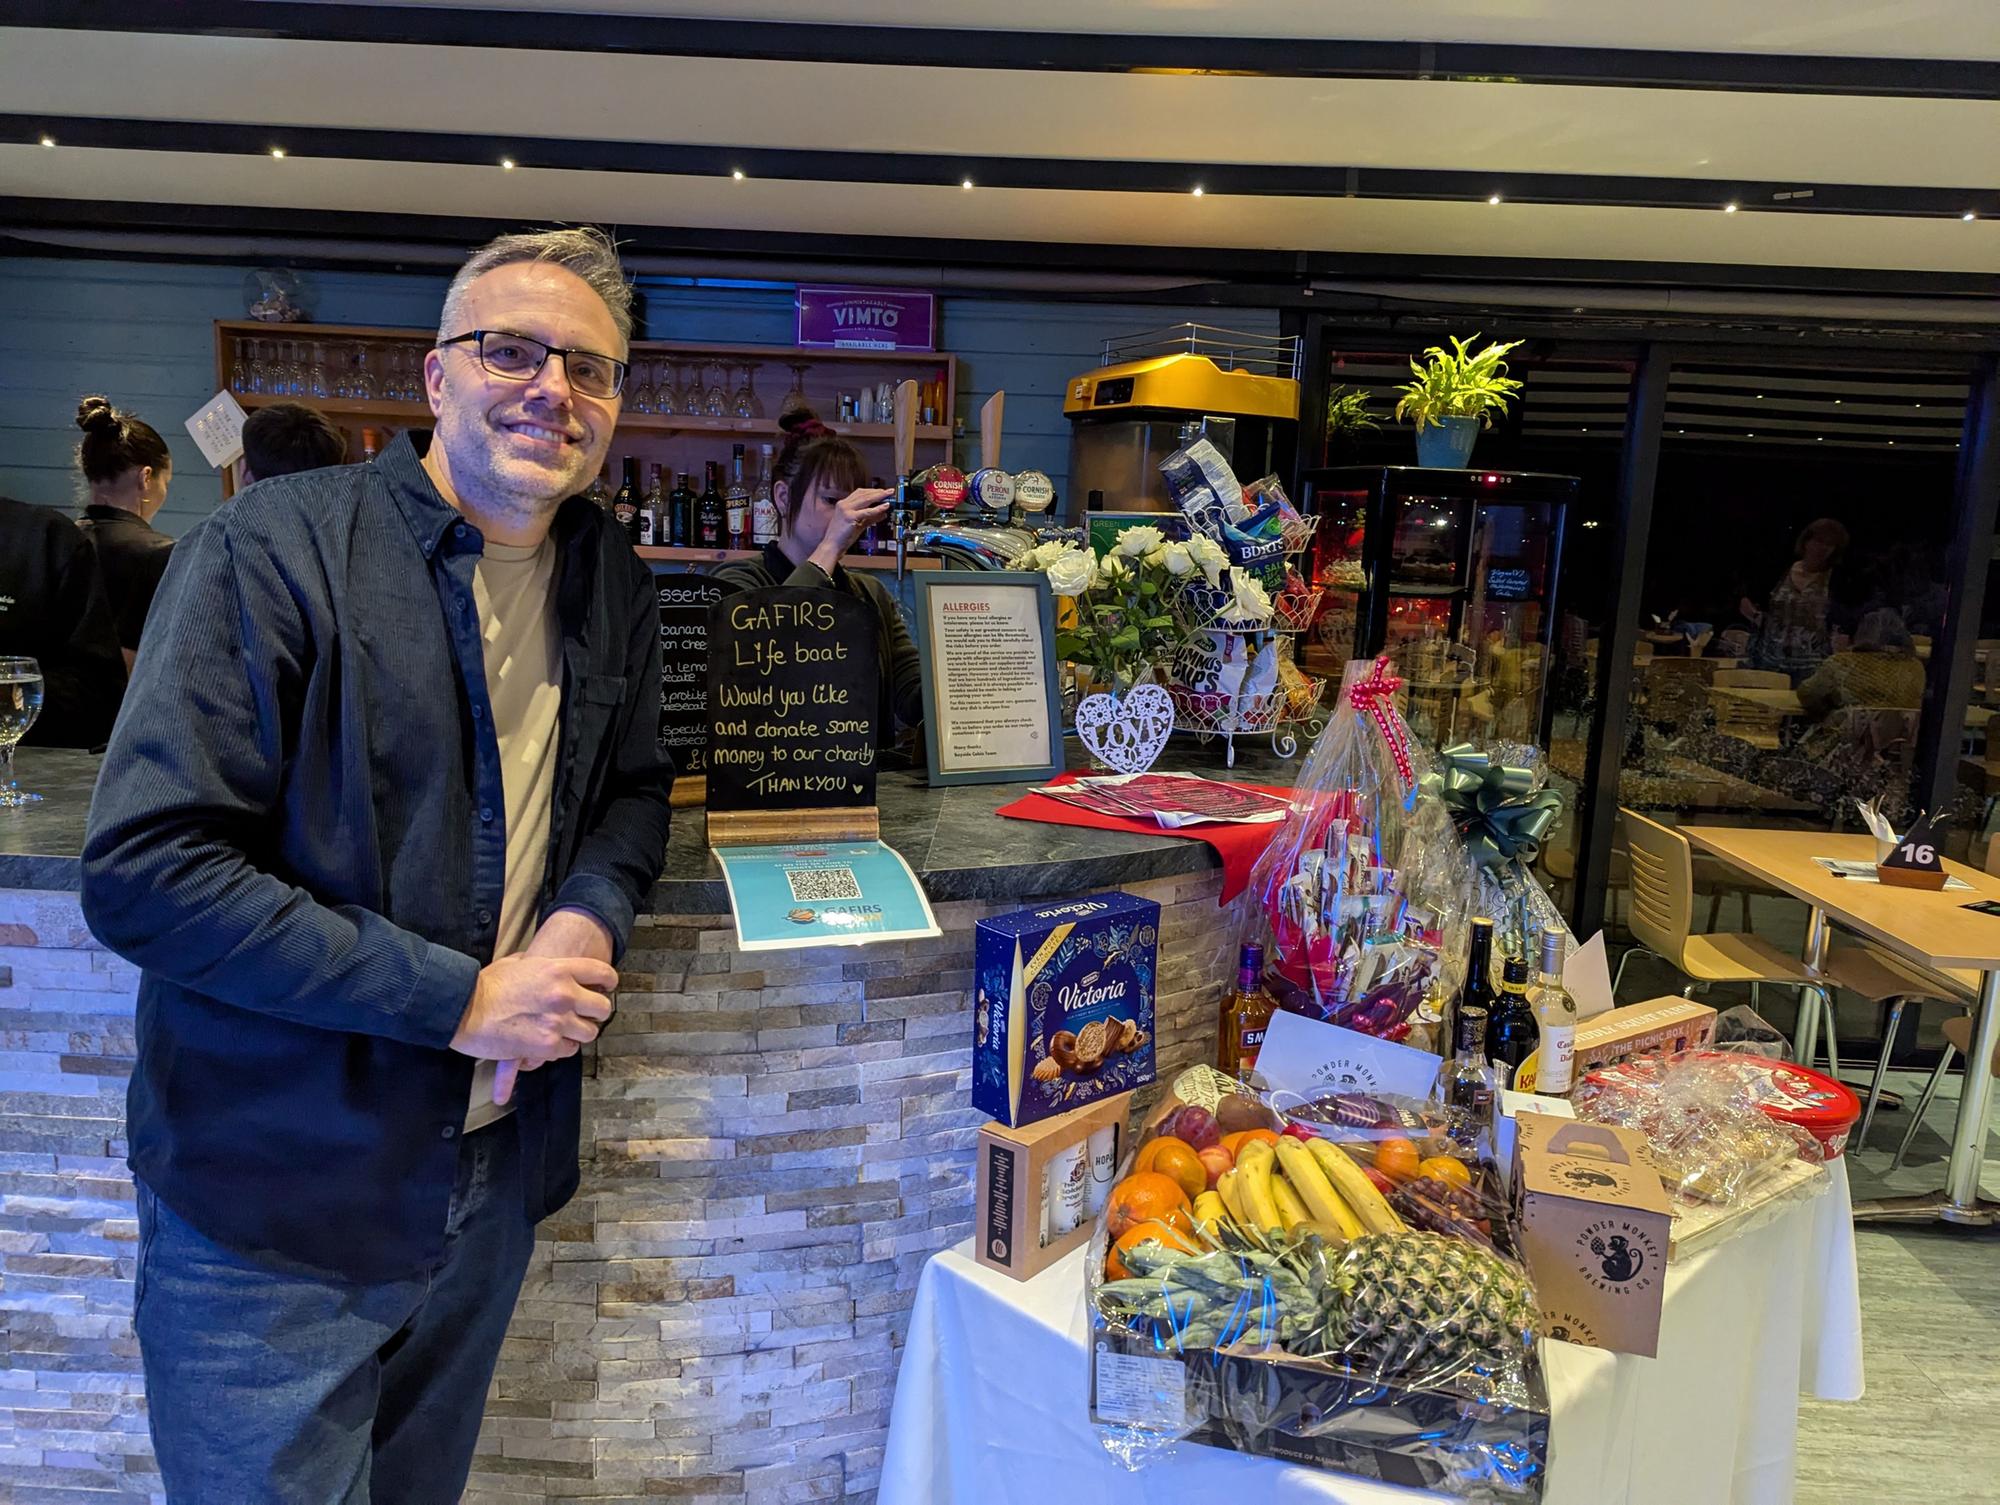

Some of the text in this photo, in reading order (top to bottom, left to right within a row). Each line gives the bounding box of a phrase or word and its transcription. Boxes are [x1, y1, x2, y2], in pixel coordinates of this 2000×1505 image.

[834, 307, 898, 327] VIMTO
[934, 480, 963, 490] CORNISH
[987, 484, 1010, 494] PERONI
[1022, 486, 1050, 495] CORNISH
[658, 584, 722, 603] sserts
[731, 601, 835, 631] GAFIRS
[943, 602, 990, 611] ALLERGIES
[660, 623, 708, 636] banana
[682, 640, 708, 650] chee
[678, 662, 708, 672] Lemo
[735, 640, 848, 676] Life boat
[1176, 646, 1222, 672] UMMUS
[720, 684, 772, 708] Would
[813, 684, 848, 704] like
[715, 720, 869, 738] and donate some
[715, 742, 875, 772] money to our charity
[1900, 843, 1934, 864] 16
[1036, 902, 1108, 919] Victoria
[1058, 980, 1126, 1012] Victoria
[992, 998, 1004, 1051] Victoria
[1614, 1014, 1659, 1030] SQUAT
[1658, 1003, 1698, 1017] FARM
[1613, 1026, 1686, 1054] THE PICNIC BOX
[1312, 1060, 1350, 1080] POWDER
[1576, 1220, 1659, 1258] POWDER MONKEY
[1579, 1266, 1650, 1294] BREWING CO
[1564, 1313, 1598, 1346] MONKE
